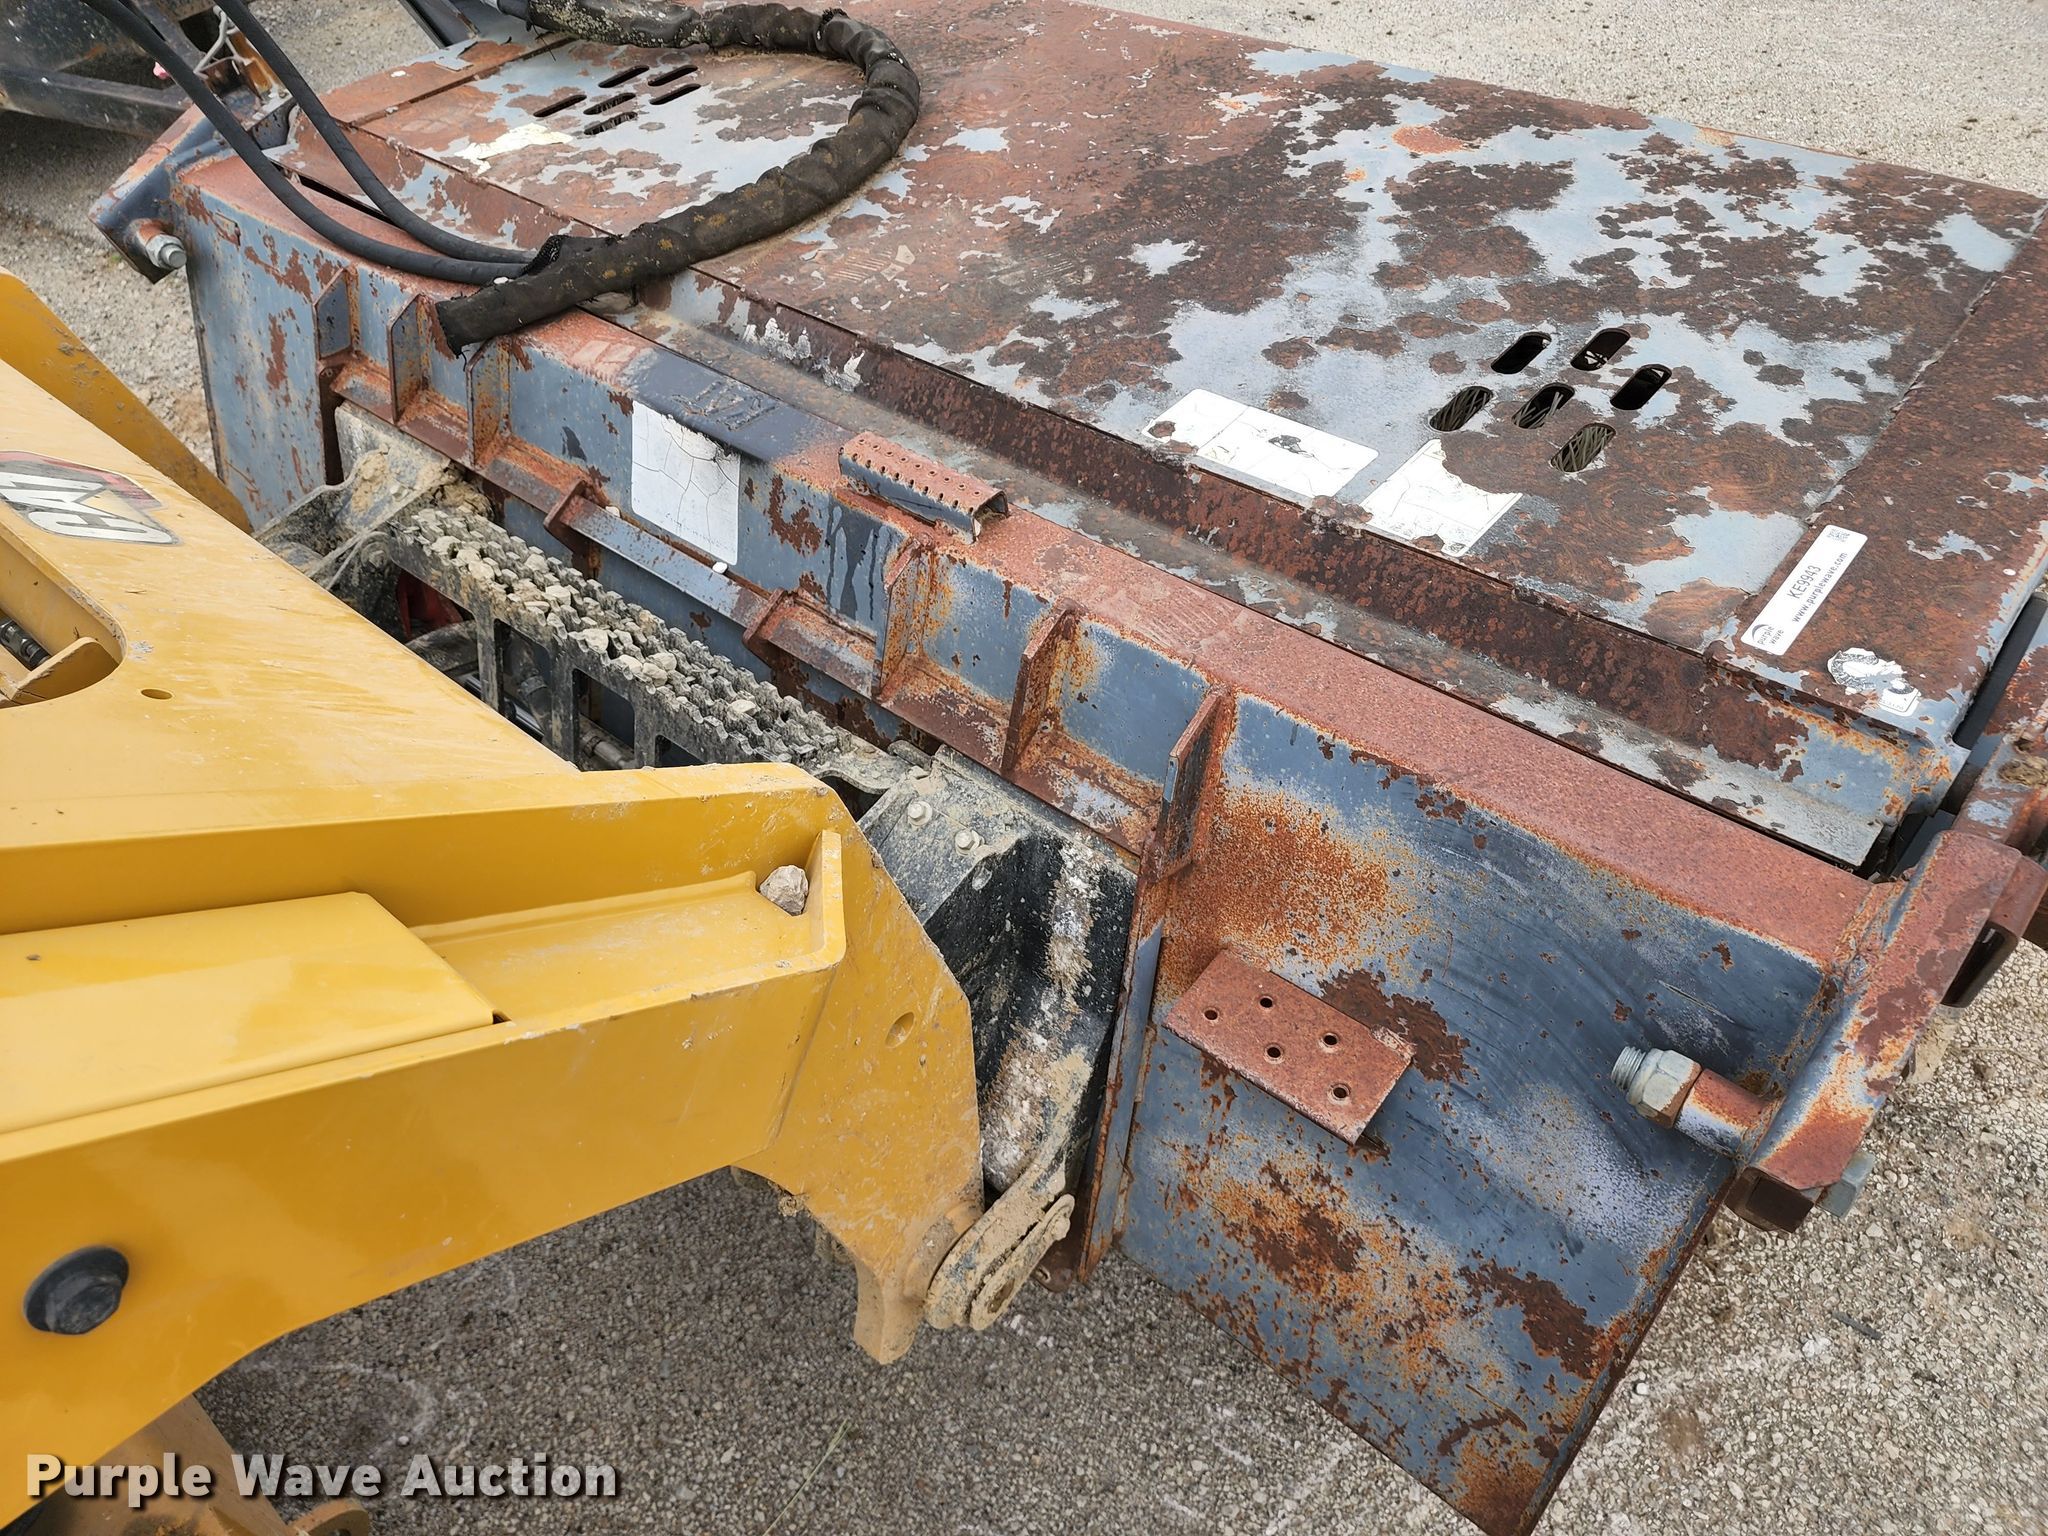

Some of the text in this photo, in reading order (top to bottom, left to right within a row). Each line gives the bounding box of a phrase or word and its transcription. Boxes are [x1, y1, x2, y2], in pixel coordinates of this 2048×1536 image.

[1787, 564, 1821, 599] KE9943
[1792, 552, 1848, 623] www.purplewave.com
[1757, 626, 1775, 645] purple
[1769, 629, 1785, 645] wave
